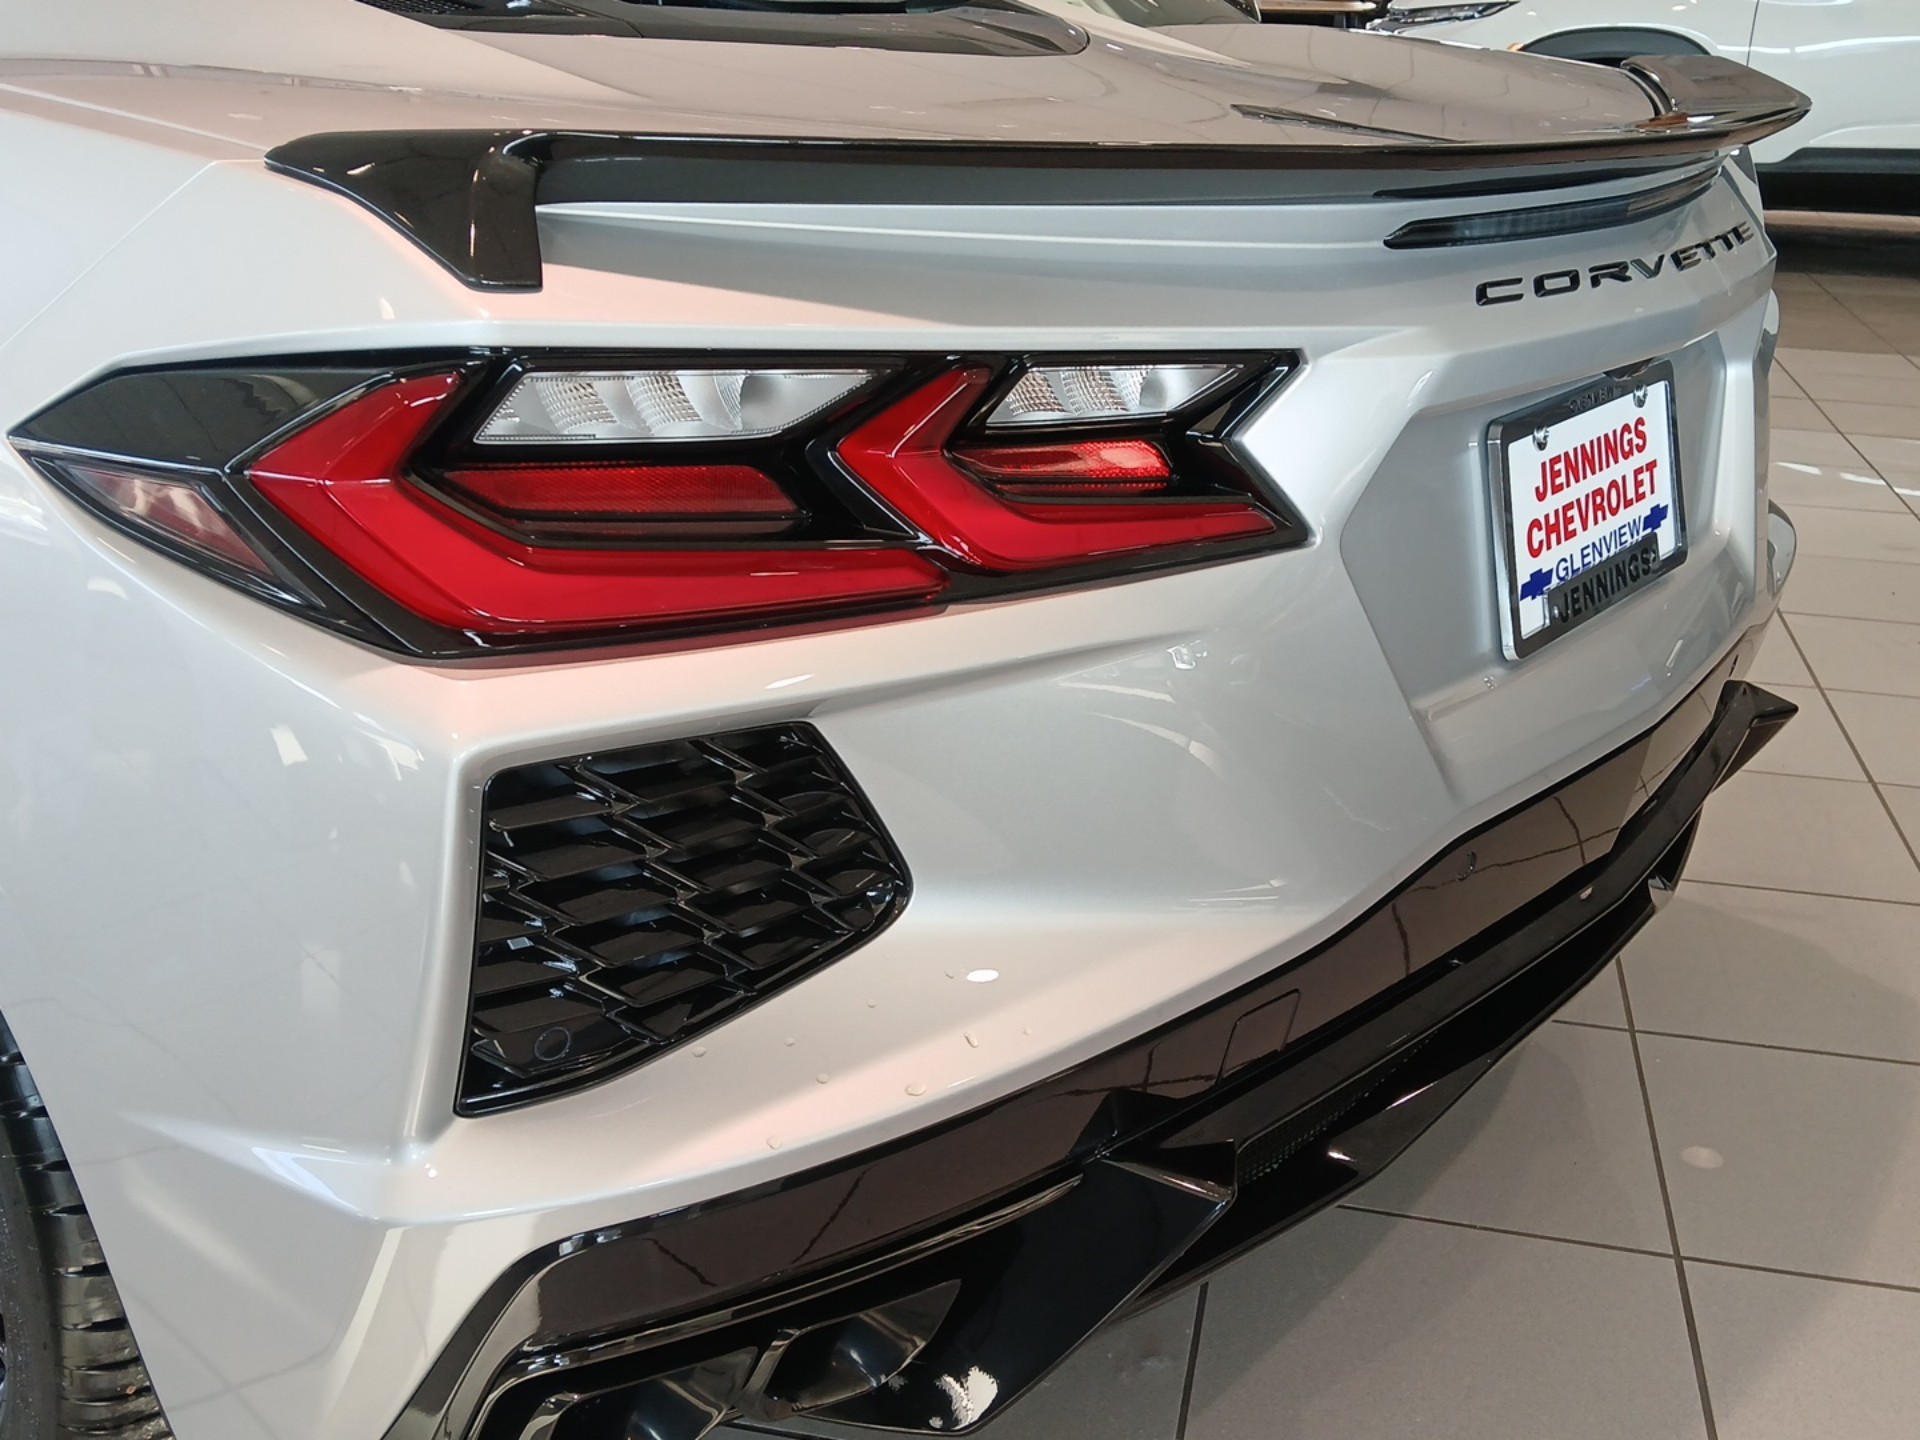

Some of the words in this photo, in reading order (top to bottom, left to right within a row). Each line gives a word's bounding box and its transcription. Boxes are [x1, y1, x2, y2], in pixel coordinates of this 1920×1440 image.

[1475, 221, 1754, 306] CORVETTE
[1535, 416, 1647, 502] JENNINGS
[1527, 459, 1658, 559] CHEVROLET
[1555, 516, 1643, 583] GLENVIEW
[1559, 547, 1652, 623] JENNINGS
